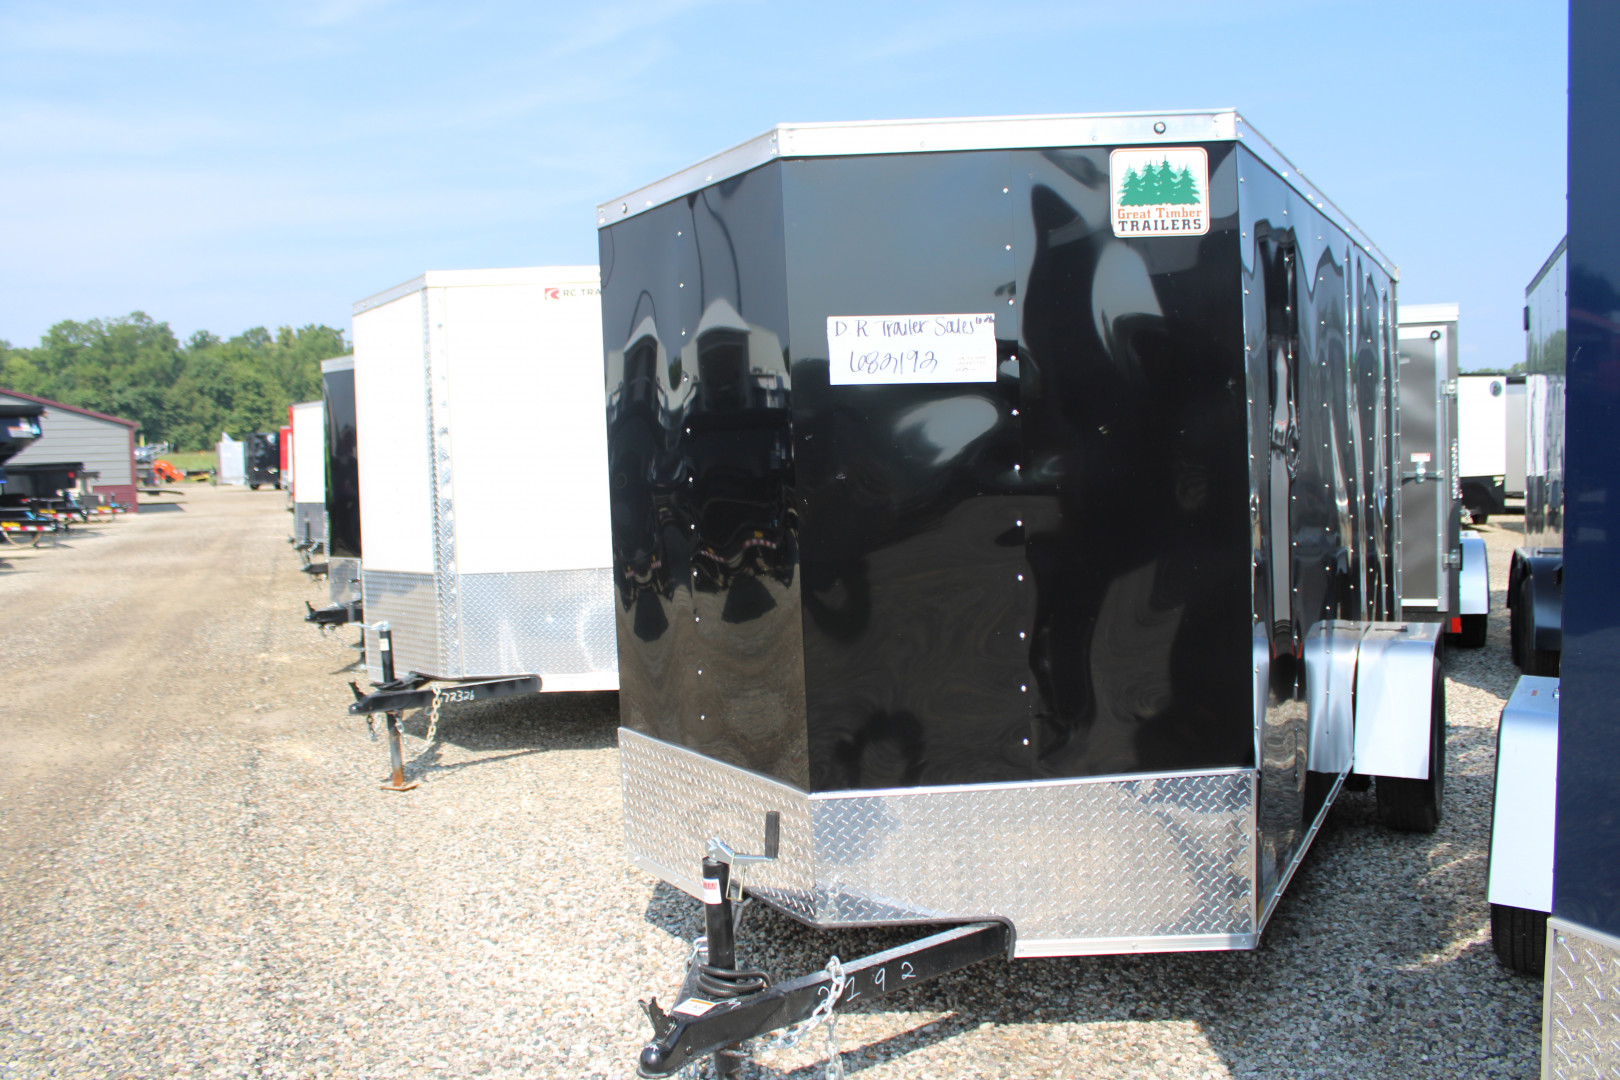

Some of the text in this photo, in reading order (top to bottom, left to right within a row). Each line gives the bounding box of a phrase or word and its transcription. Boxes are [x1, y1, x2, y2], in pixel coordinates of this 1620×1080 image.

[1118, 207, 1202, 219] Great Timber
[1118, 218, 1202, 232] TRAILERS
[563, 289, 577, 297] RC
[875, 319, 930, 338] Trailer
[935, 316, 975, 337] Sales
[850, 350, 938, 375] 682192
